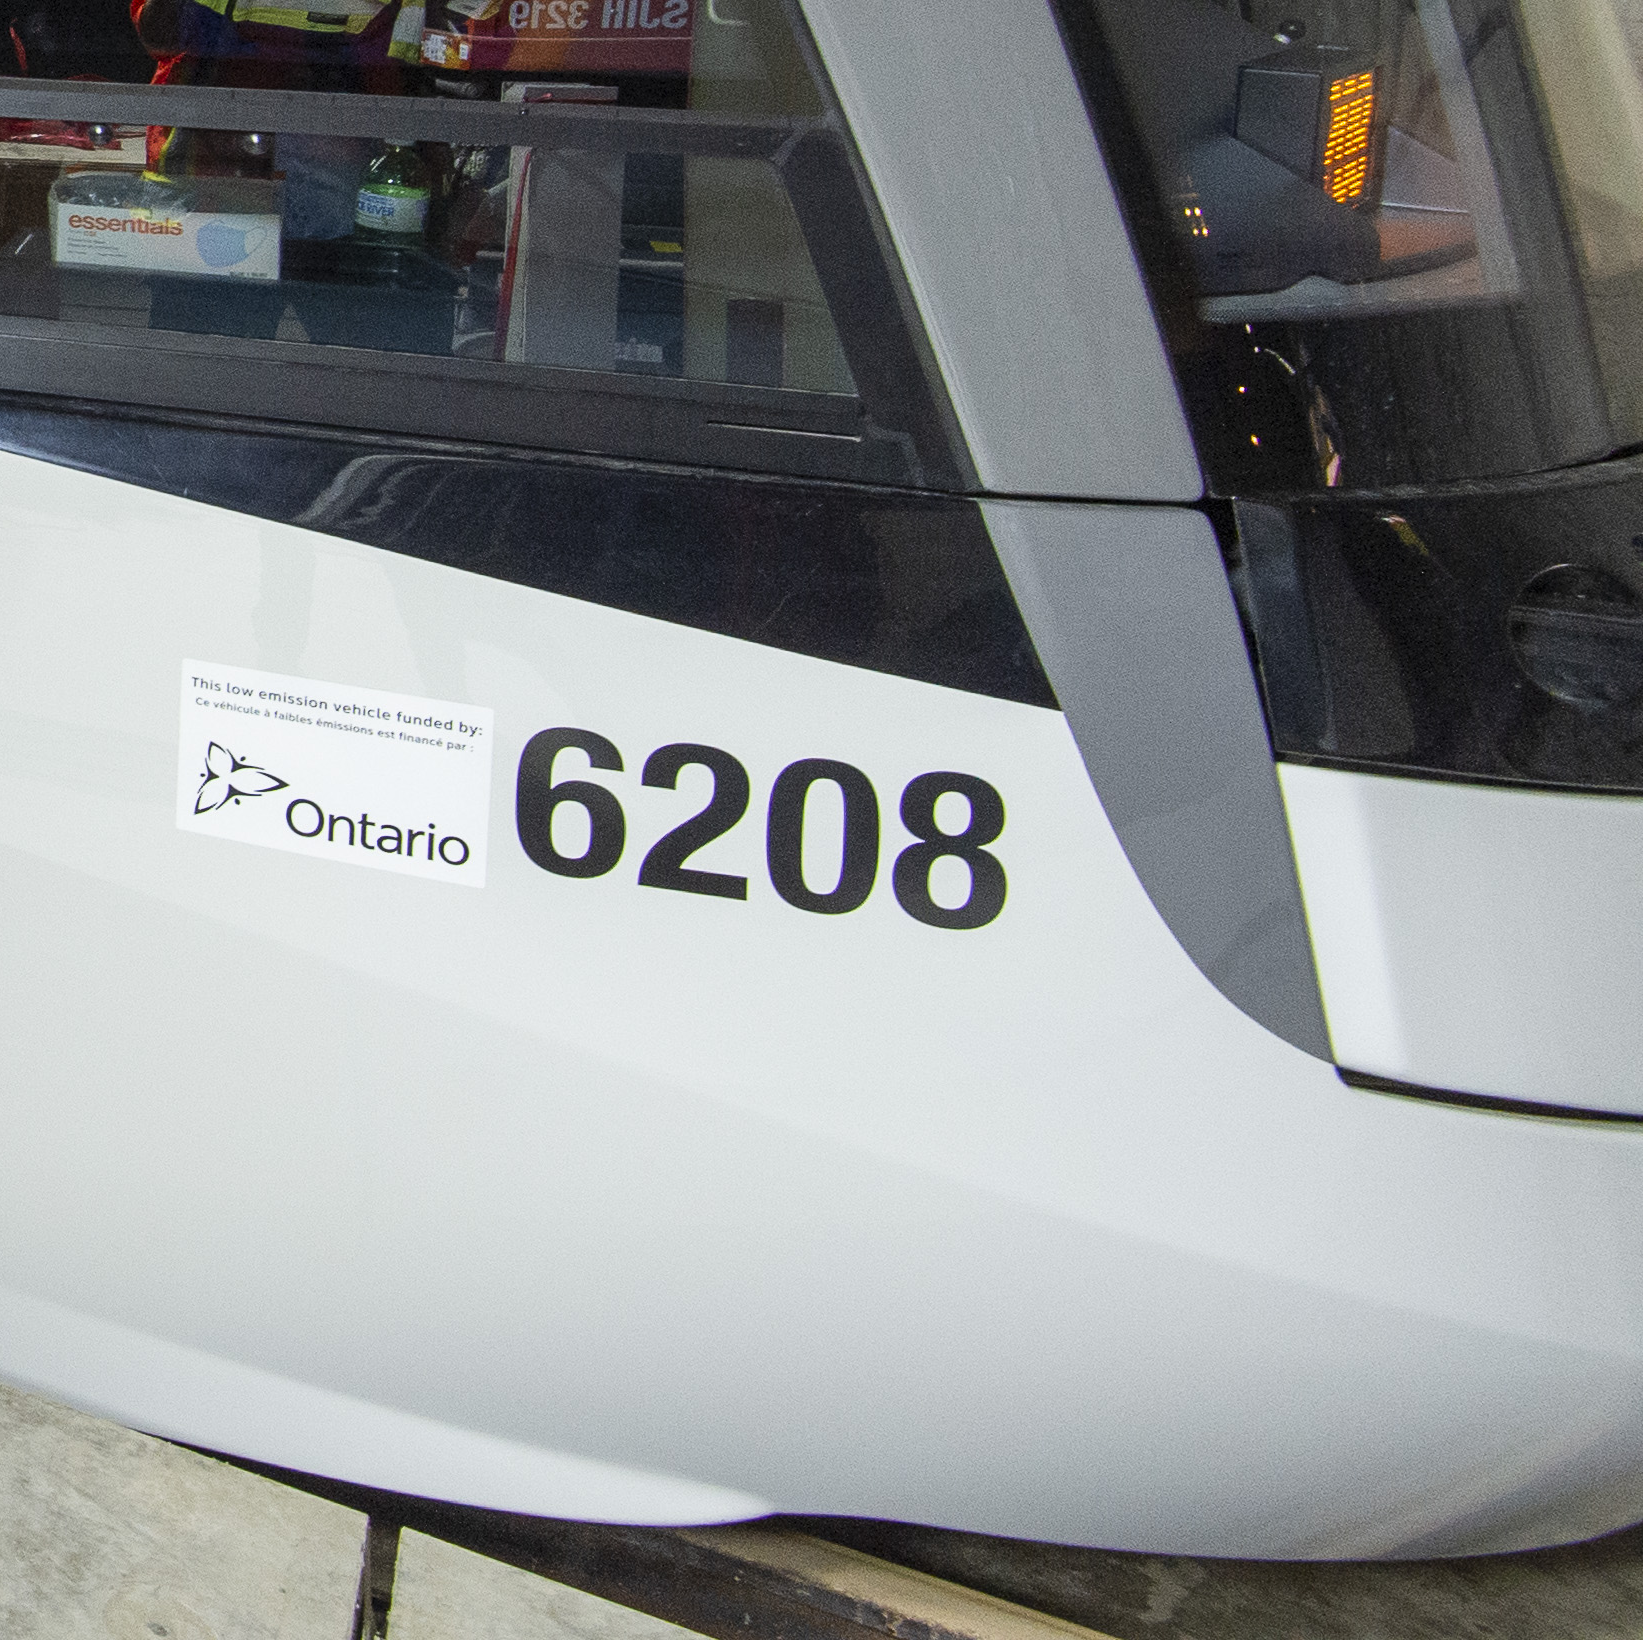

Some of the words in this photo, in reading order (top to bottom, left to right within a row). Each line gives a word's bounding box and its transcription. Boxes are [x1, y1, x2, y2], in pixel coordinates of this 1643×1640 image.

[68, 214, 183, 236] essentials
[192, 676, 222, 692] This
[227, 683, 253, 698] low
[259, 690, 327, 710] emission
[333, 701, 391, 721] vehicle
[397, 711, 454, 731] funded
[459, 721, 483, 738] by:
[195, 697, 209, 708] Ce
[213, 700, 260, 716] véhicule
[264, 708, 271, 718] à
[274, 709, 313, 726] faibles
[316, 717, 373, 736] émissions
[377, 728, 395, 740] est
[398, 731, 443, 748] financé
[447, 739, 467, 754] par
[285, 798, 471, 867] Ontario
[514, 725, 1009, 931] 6208
